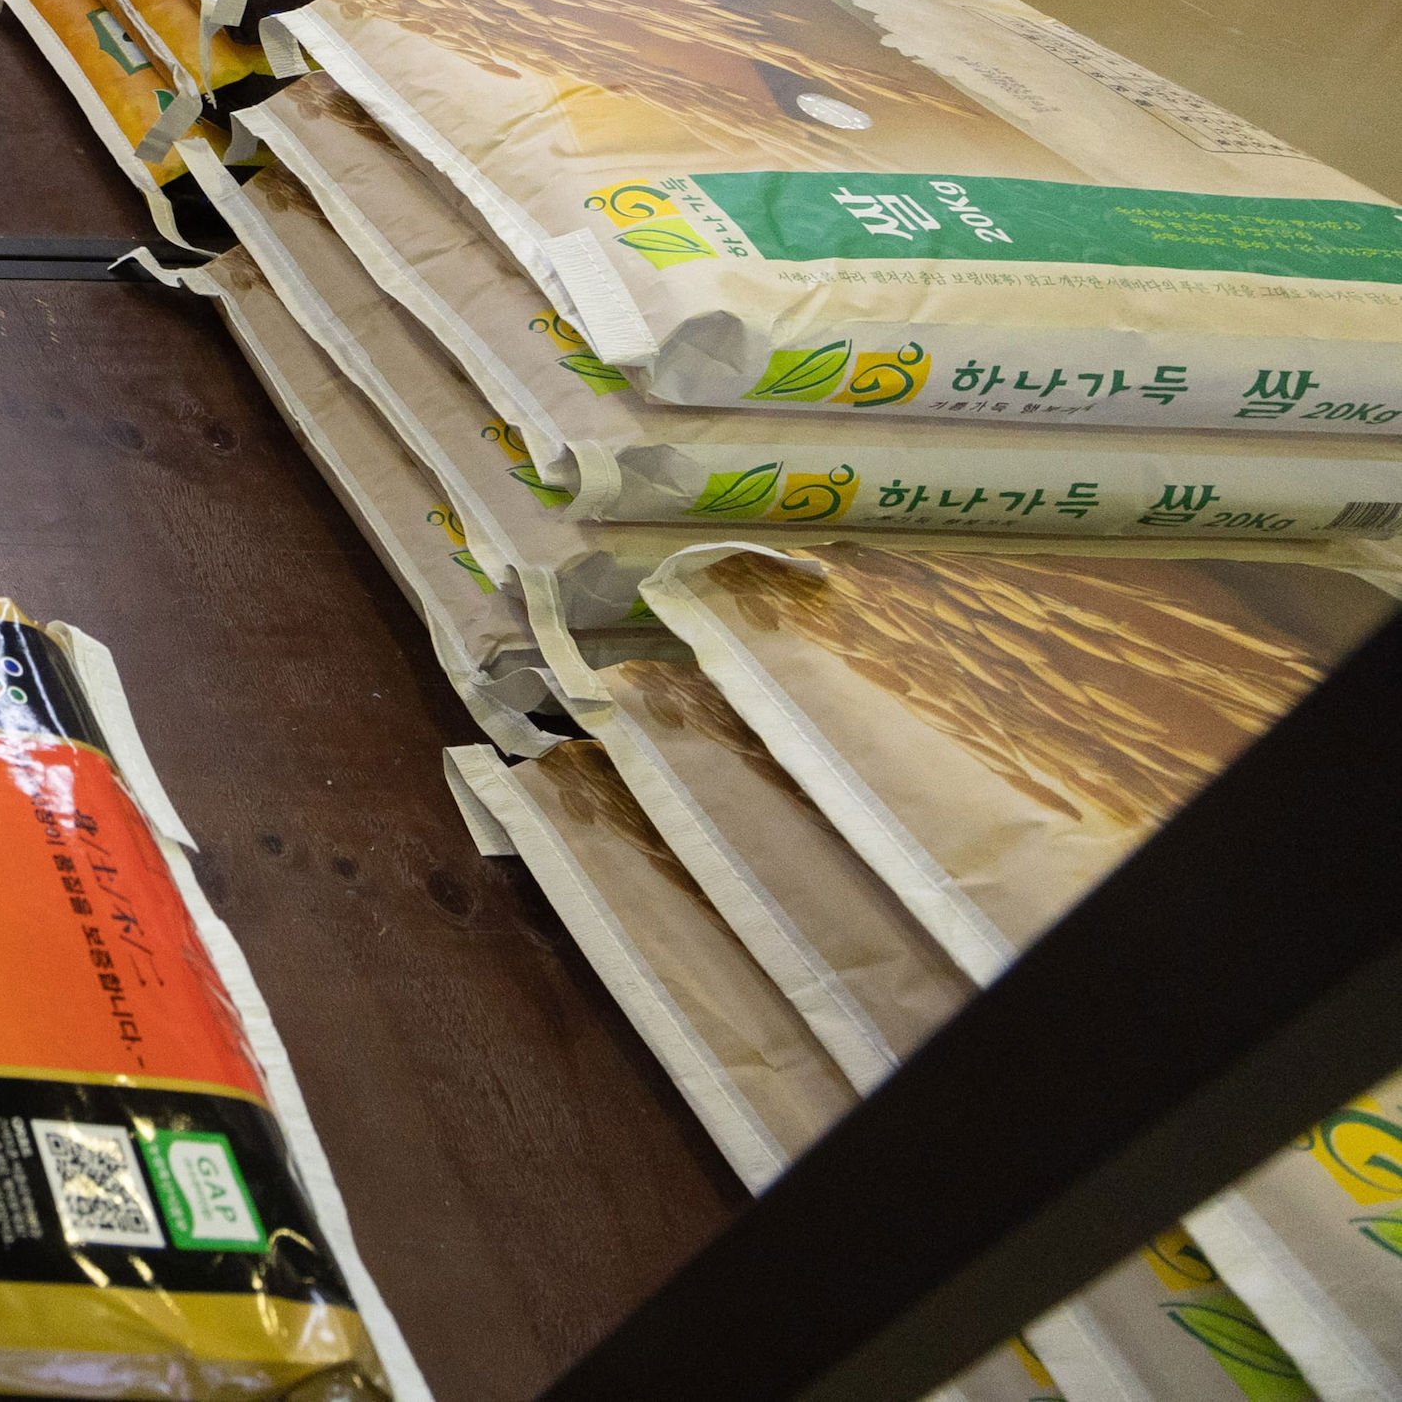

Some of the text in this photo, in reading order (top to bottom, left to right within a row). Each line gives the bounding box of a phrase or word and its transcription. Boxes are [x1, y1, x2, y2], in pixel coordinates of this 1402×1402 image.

[660, 175, 750, 258] 하나가득
[830, 187, 943, 241] 쌀
[929, 181, 1014, 244] 20Kg
[920, 274, 945, 284] 충남
[1025, 276, 1055, 286] 맑고
[952, 359, 1189, 406] 하나가득
[1233, 369, 1320, 419] 쌀
[878, 479, 1100, 519] 하나가득
[1136, 483, 1221, 529] 쌀
[54, 850, 146, 1054] 품질을 보증합니다.
[195, 1154, 241, 1227] GAP
